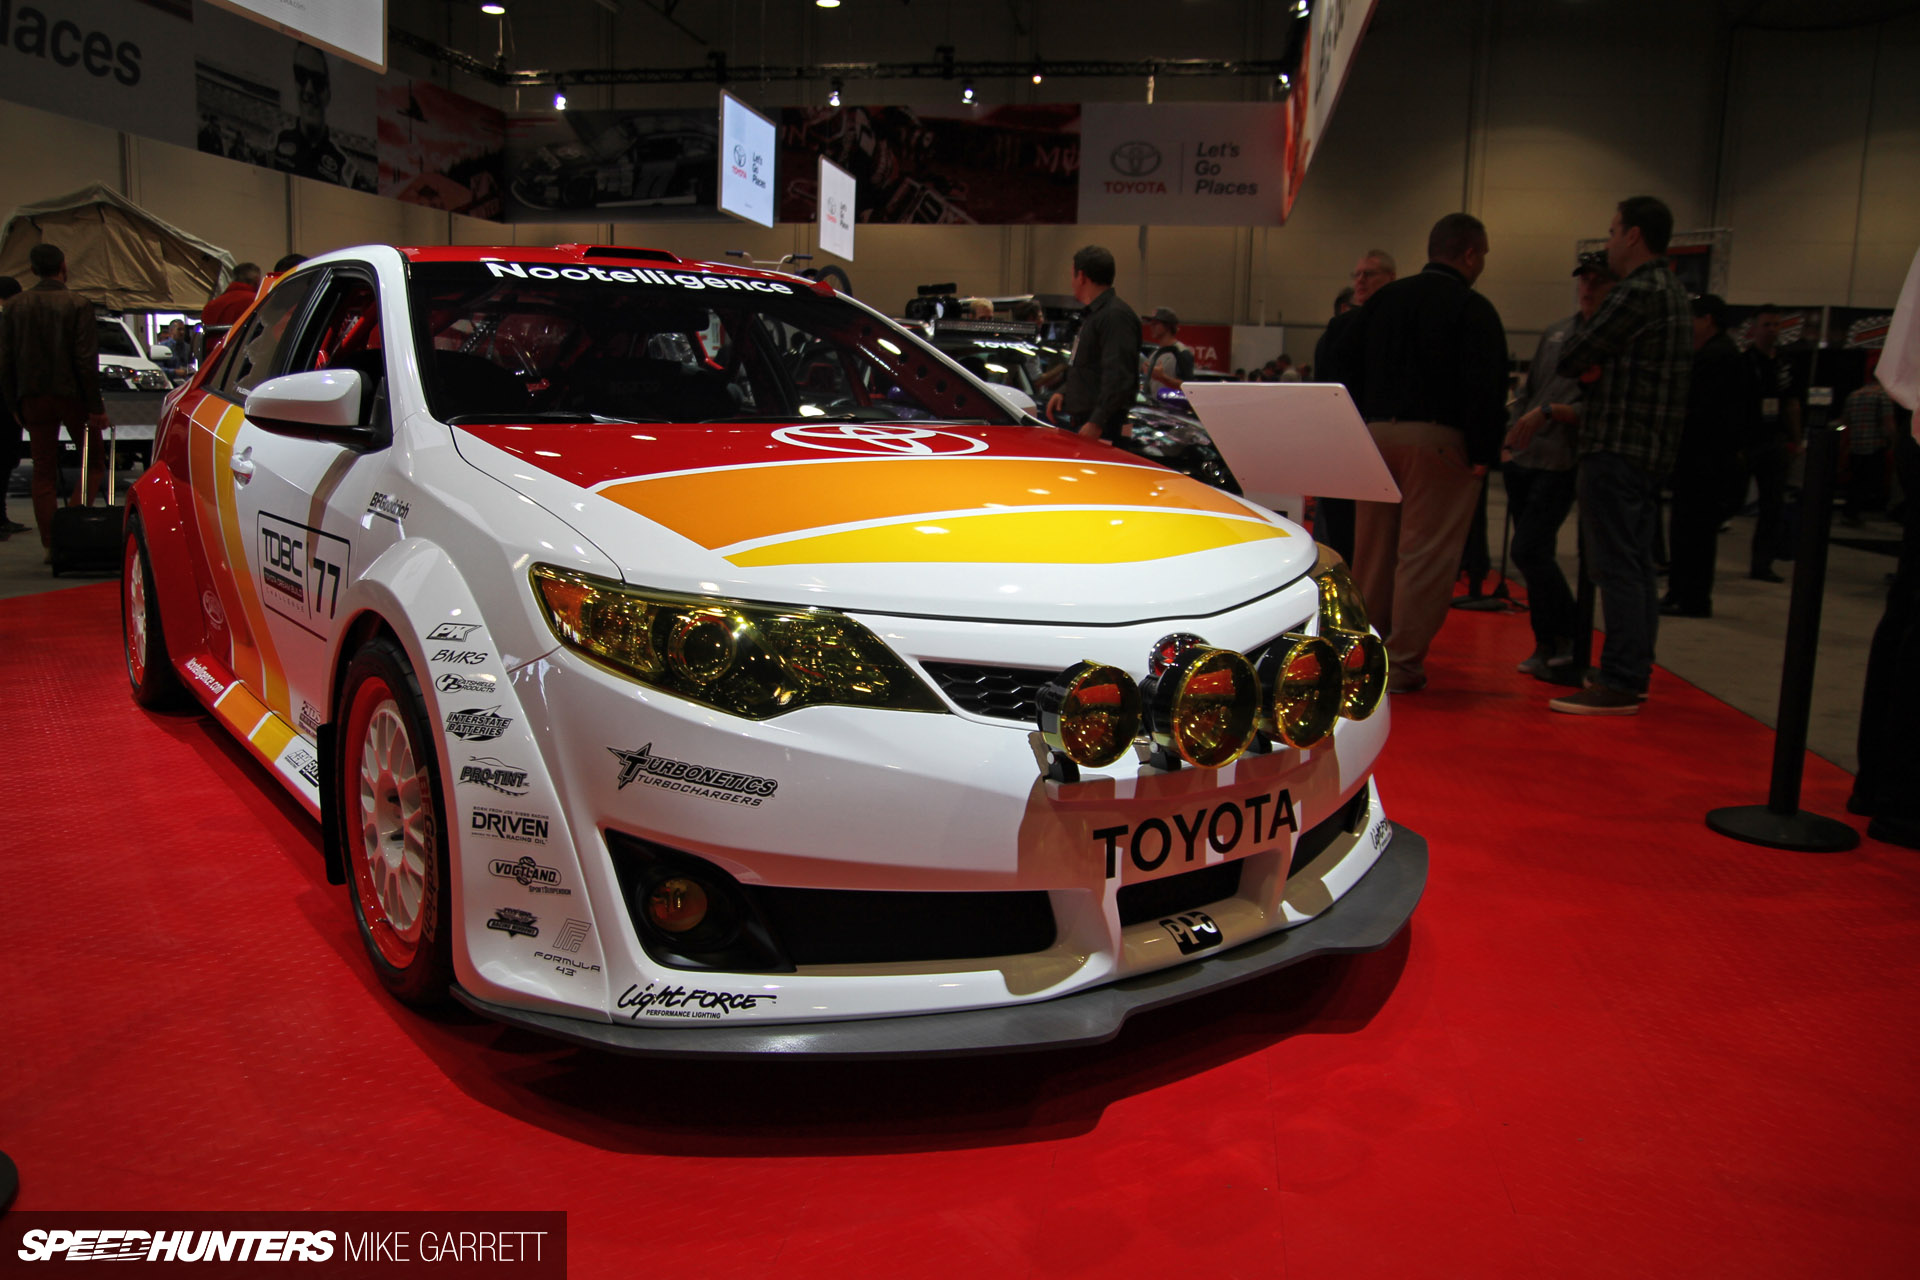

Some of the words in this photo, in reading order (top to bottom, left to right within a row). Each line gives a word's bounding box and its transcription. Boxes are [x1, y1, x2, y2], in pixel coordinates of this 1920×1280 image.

[1197, 142, 1241, 158] Let's
[1195, 160, 1221, 176] Go
[1104, 181, 1167, 194] TOYOTA
[1195, 179, 1258, 195] Places
[485, 262, 794, 295] Nootelligence
[370, 491, 410, 519] BFGoodrich
[262, 527, 303, 578] TDBC
[313, 557, 341, 620] 77
[431, 649, 488, 665] BMRS
[448, 713, 511, 728] INTERSTATE
[448, 723, 503, 737] BATTERIES
[460, 766, 528, 788] PRO-TINT
[622, 754, 778, 797] TURBONETICS
[637, 774, 763, 807] TURBOCHARGERS
[472, 811, 549, 839] DRIVEN
[1093, 788, 1299, 880] TOYOTA
[506, 834, 532, 843] RACING
[495, 861, 557, 883] VOGTLAND
[534, 951, 601, 972] FORMULA
[556, 966, 575, 977] 43
[645, 1009, 691, 1018] PERFORMANCE
[691, 1011, 721, 1019] LIGHTING
